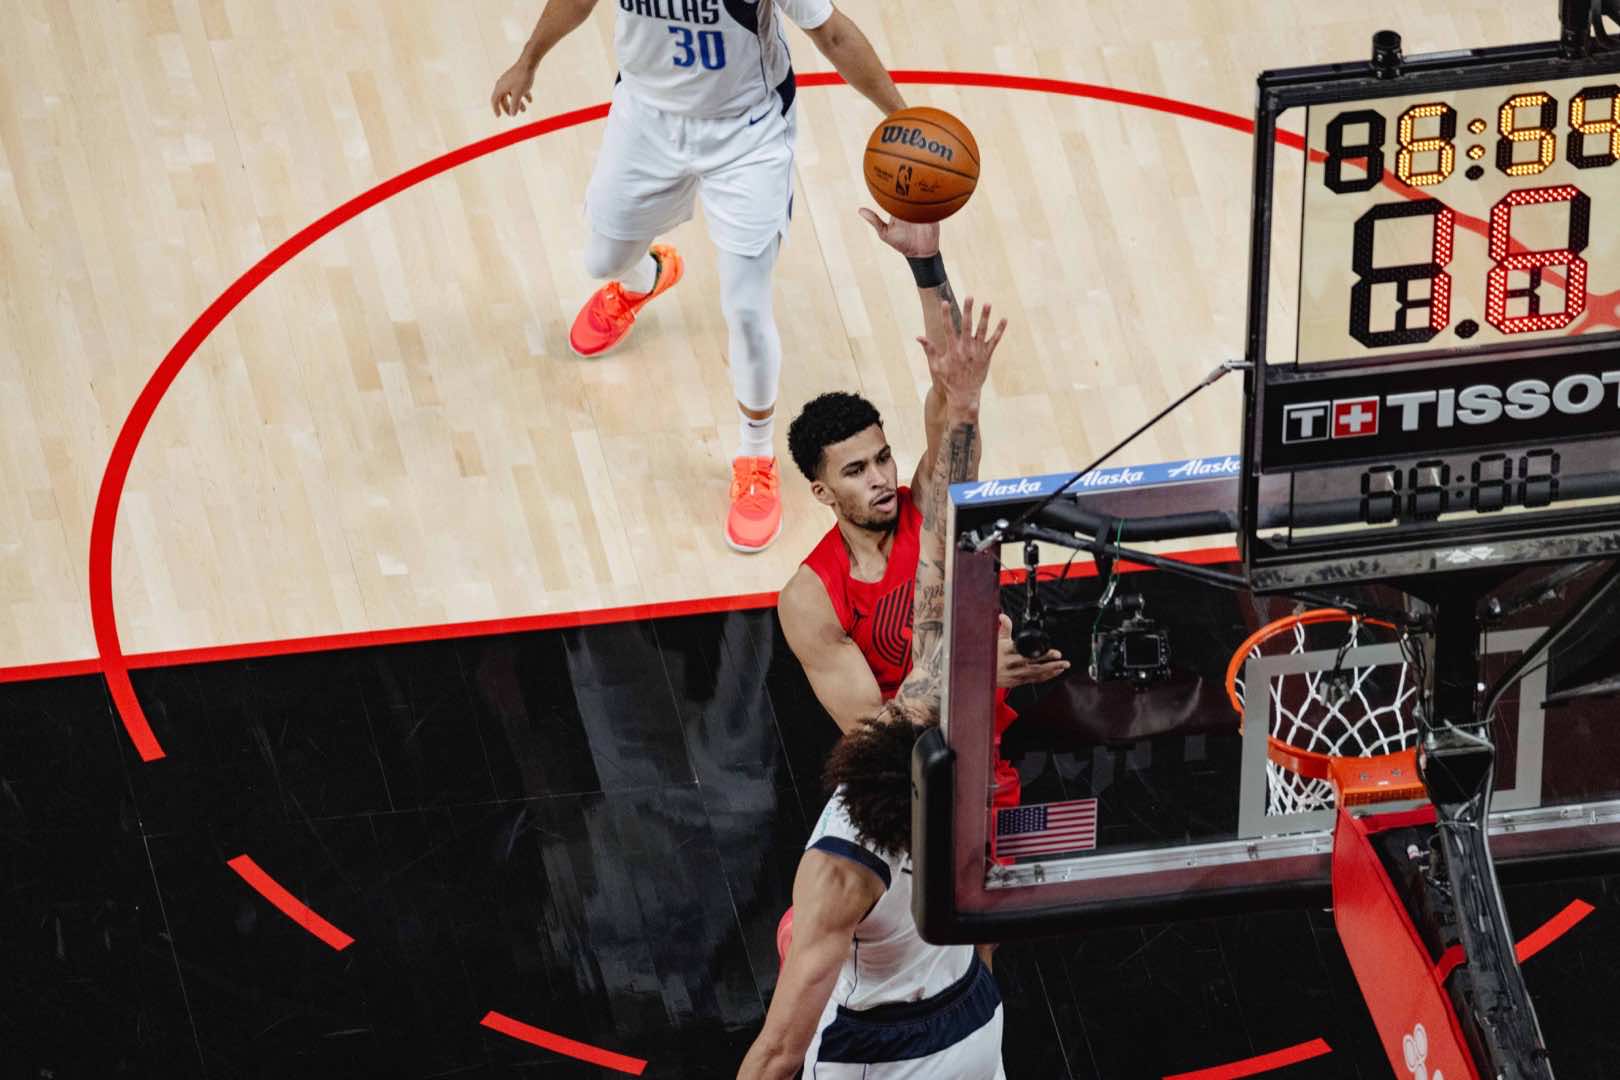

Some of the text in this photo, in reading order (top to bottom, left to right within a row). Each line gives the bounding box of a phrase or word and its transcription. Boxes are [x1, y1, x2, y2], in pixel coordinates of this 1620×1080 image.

[668, 25, 726, 70] 30
[881, 125, 953, 161] Wilson
[963, 478, 1042, 499] Alaska
[1063, 467, 1144, 488] Alaska
